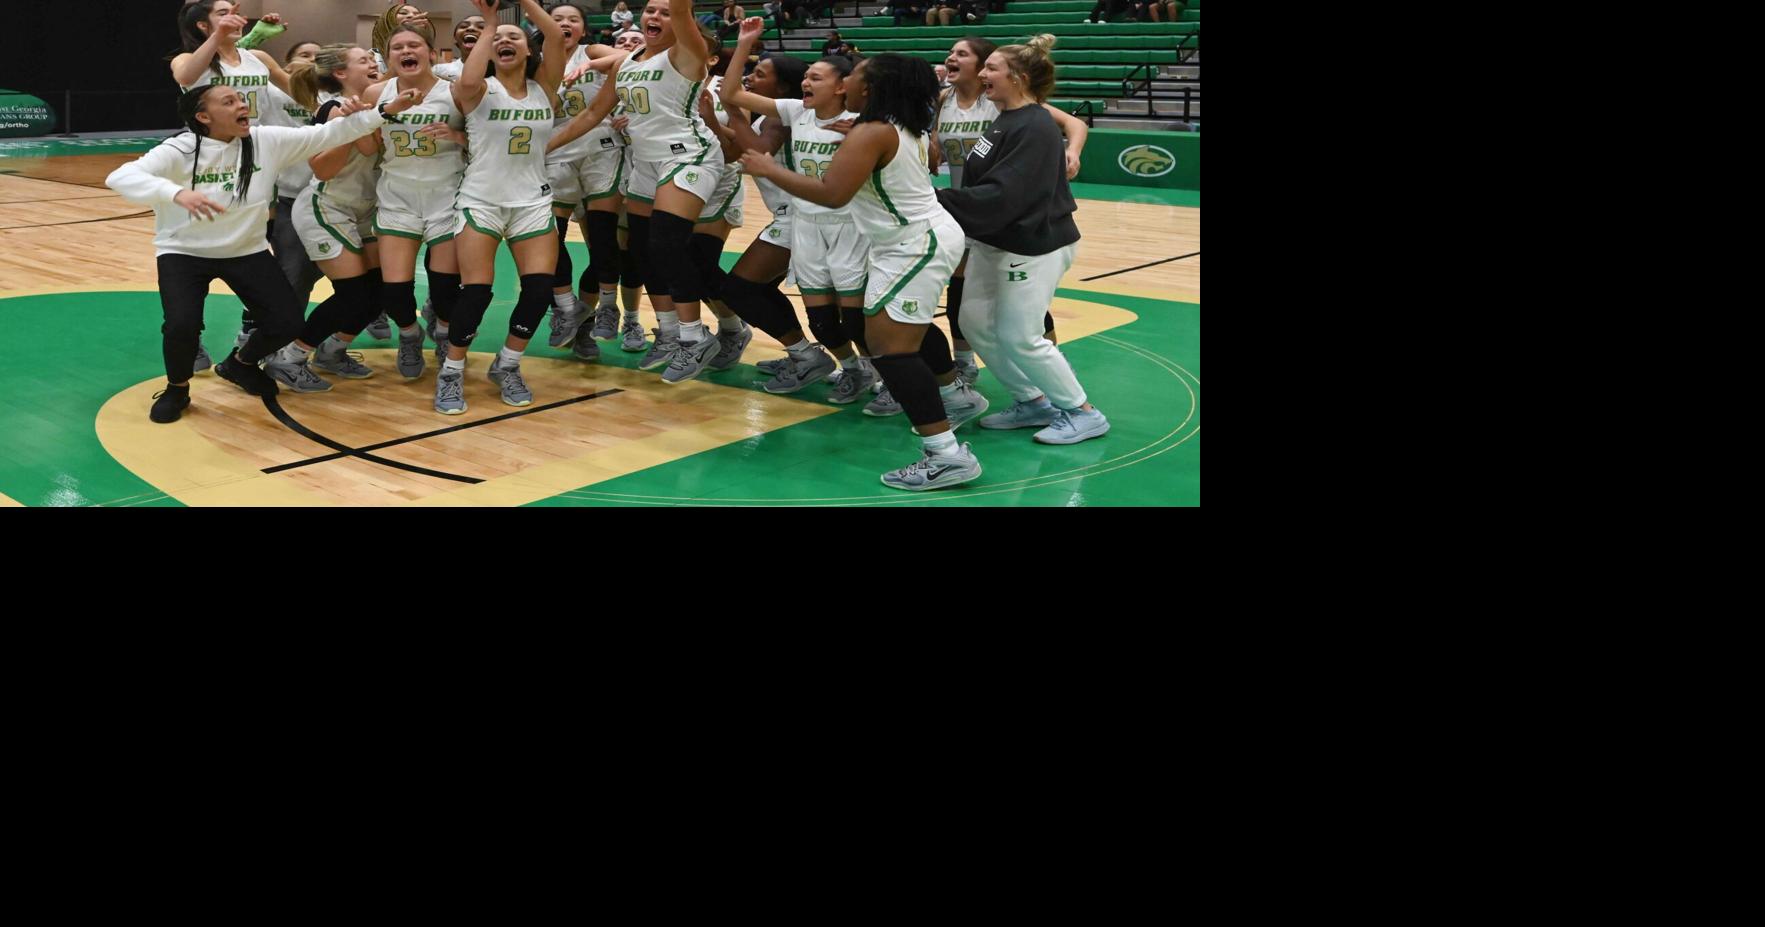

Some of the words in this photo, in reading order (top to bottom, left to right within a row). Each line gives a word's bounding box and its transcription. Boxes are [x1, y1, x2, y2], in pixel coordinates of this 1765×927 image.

[210, 75, 268, 86] BUFORD
[617, 70, 664, 82] UFORD
[11, 105, 47, 114] Georgia
[488, 107, 552, 121] BUFORD
[383, 113, 451, 125] FORD
[389, 129, 437, 157] 23
[508, 125, 532, 155] 2
[793, 140, 842, 155] BUFOR
[1008, 271, 1028, 281] B
